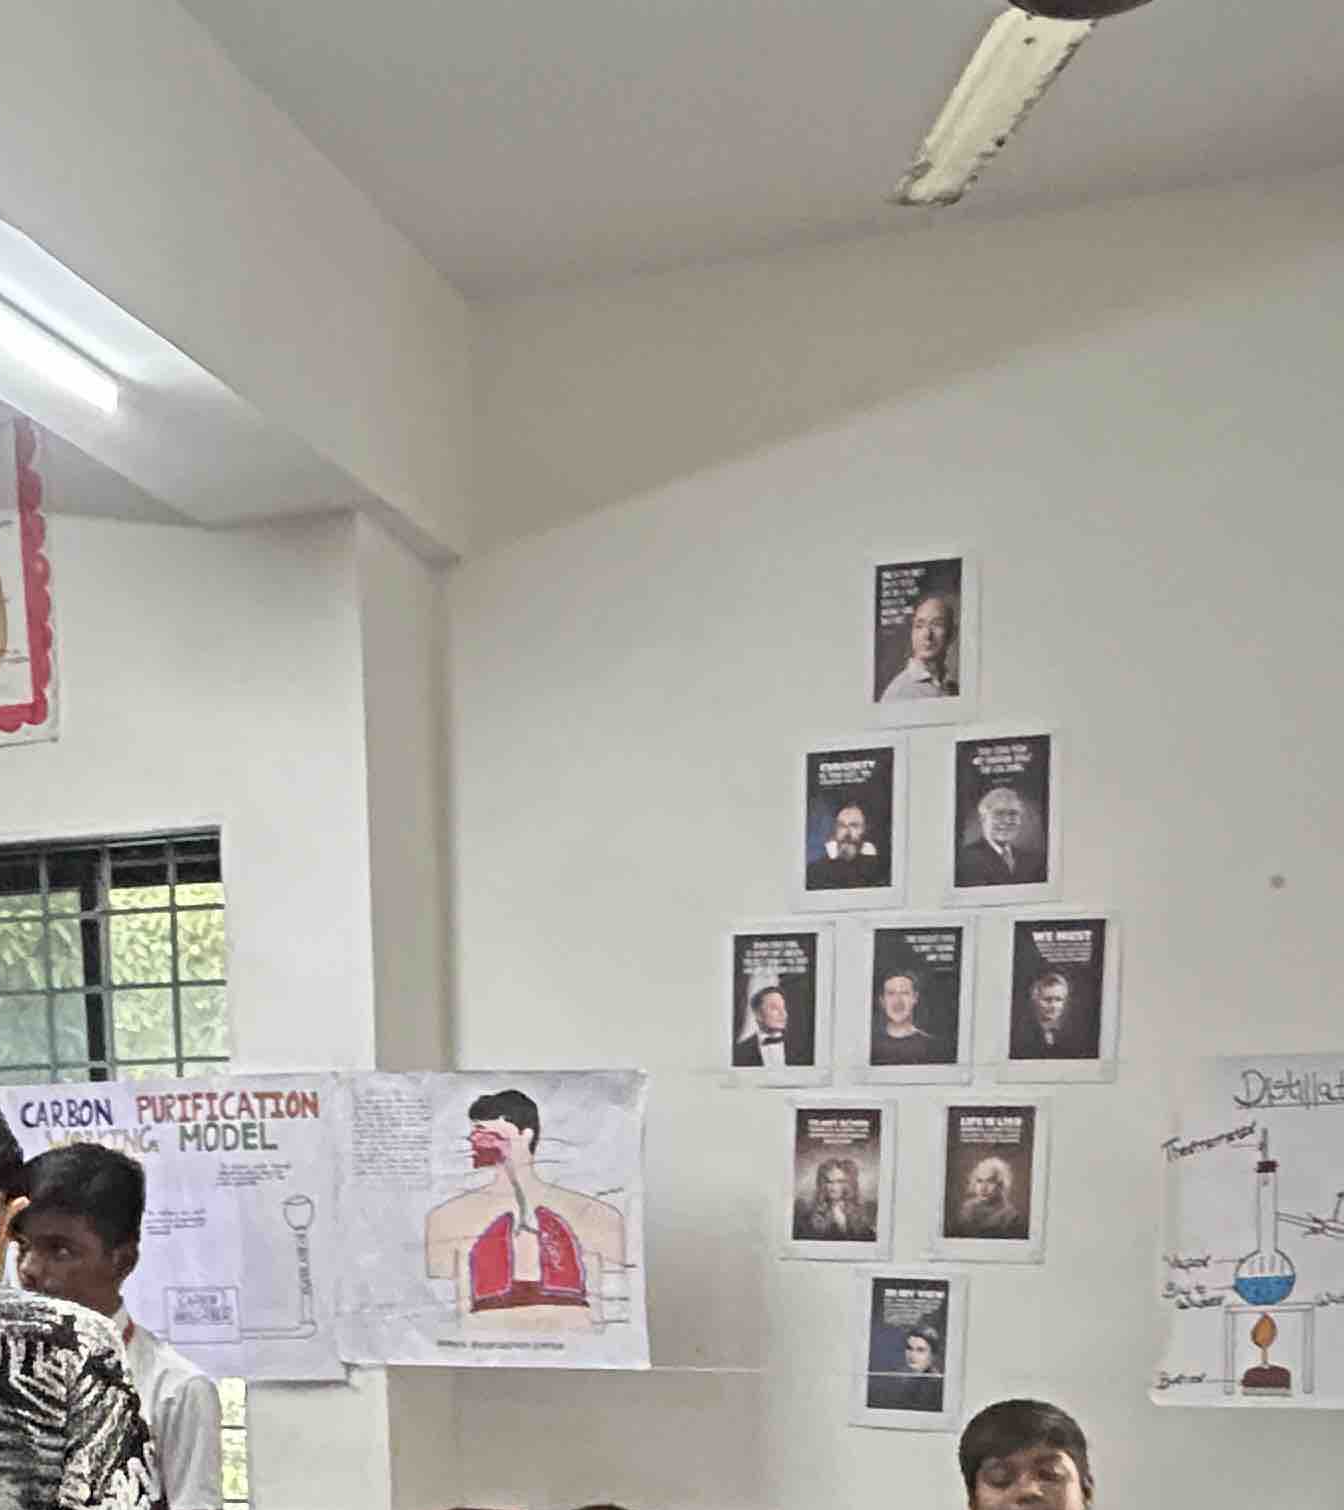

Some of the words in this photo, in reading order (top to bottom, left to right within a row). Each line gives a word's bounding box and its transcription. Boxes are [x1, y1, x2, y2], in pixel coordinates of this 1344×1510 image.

[19, 1097, 114, 1129] CARBON
[135, 1090, 321, 1124] PURIFICATION
[179, 1121, 278, 1152] MODEL
